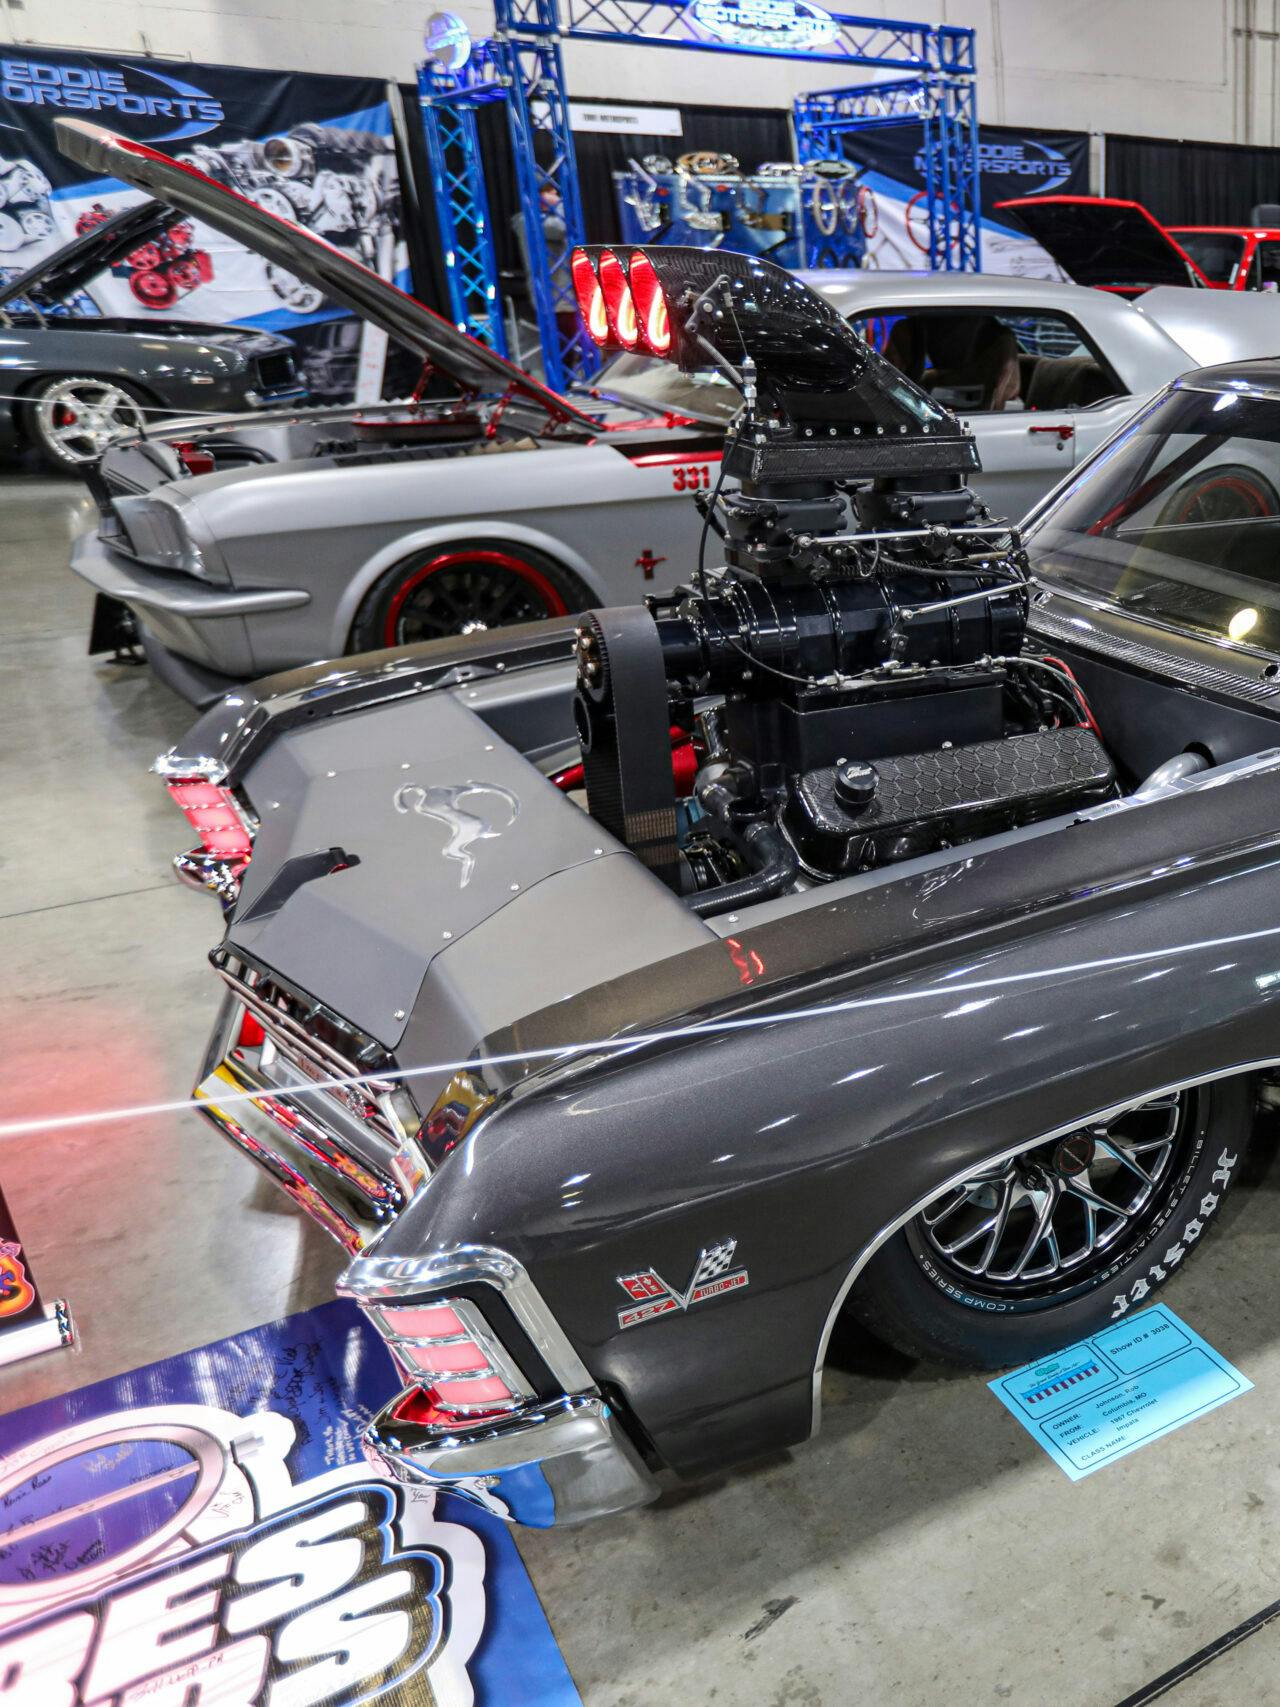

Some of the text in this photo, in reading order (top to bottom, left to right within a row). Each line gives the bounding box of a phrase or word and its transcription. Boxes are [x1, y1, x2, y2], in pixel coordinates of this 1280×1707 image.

[1, 58, 128, 93] EDDIE
[1, 80, 225, 121] ORSPORTS
[673, 464, 710, 491] 331
[1101, 1139, 1205, 1281] BILLET SPECIALTIES
[1112, 1147, 1238, 1319] Hoosier
[700, 1277, 742, 1297] TURBO-JET
[922, 1260, 1007, 1312] COMP SERIES
[623, 1301, 672, 1325] 427
[1110, 1341, 1133, 1355] Show
[1133, 1334, 1144, 1345] ID
[1052, 1413, 1081, 1430] OWNER:
[1059, 1424, 1083, 1438] FROM:
[1067, 1427, 1100, 1446] VEHICLE:
[1126, 1398, 1158, 1416] Chevrolet
[1116, 1418, 1140, 1432] Impala
[1081, 1446, 1106, 1461] CLASS
